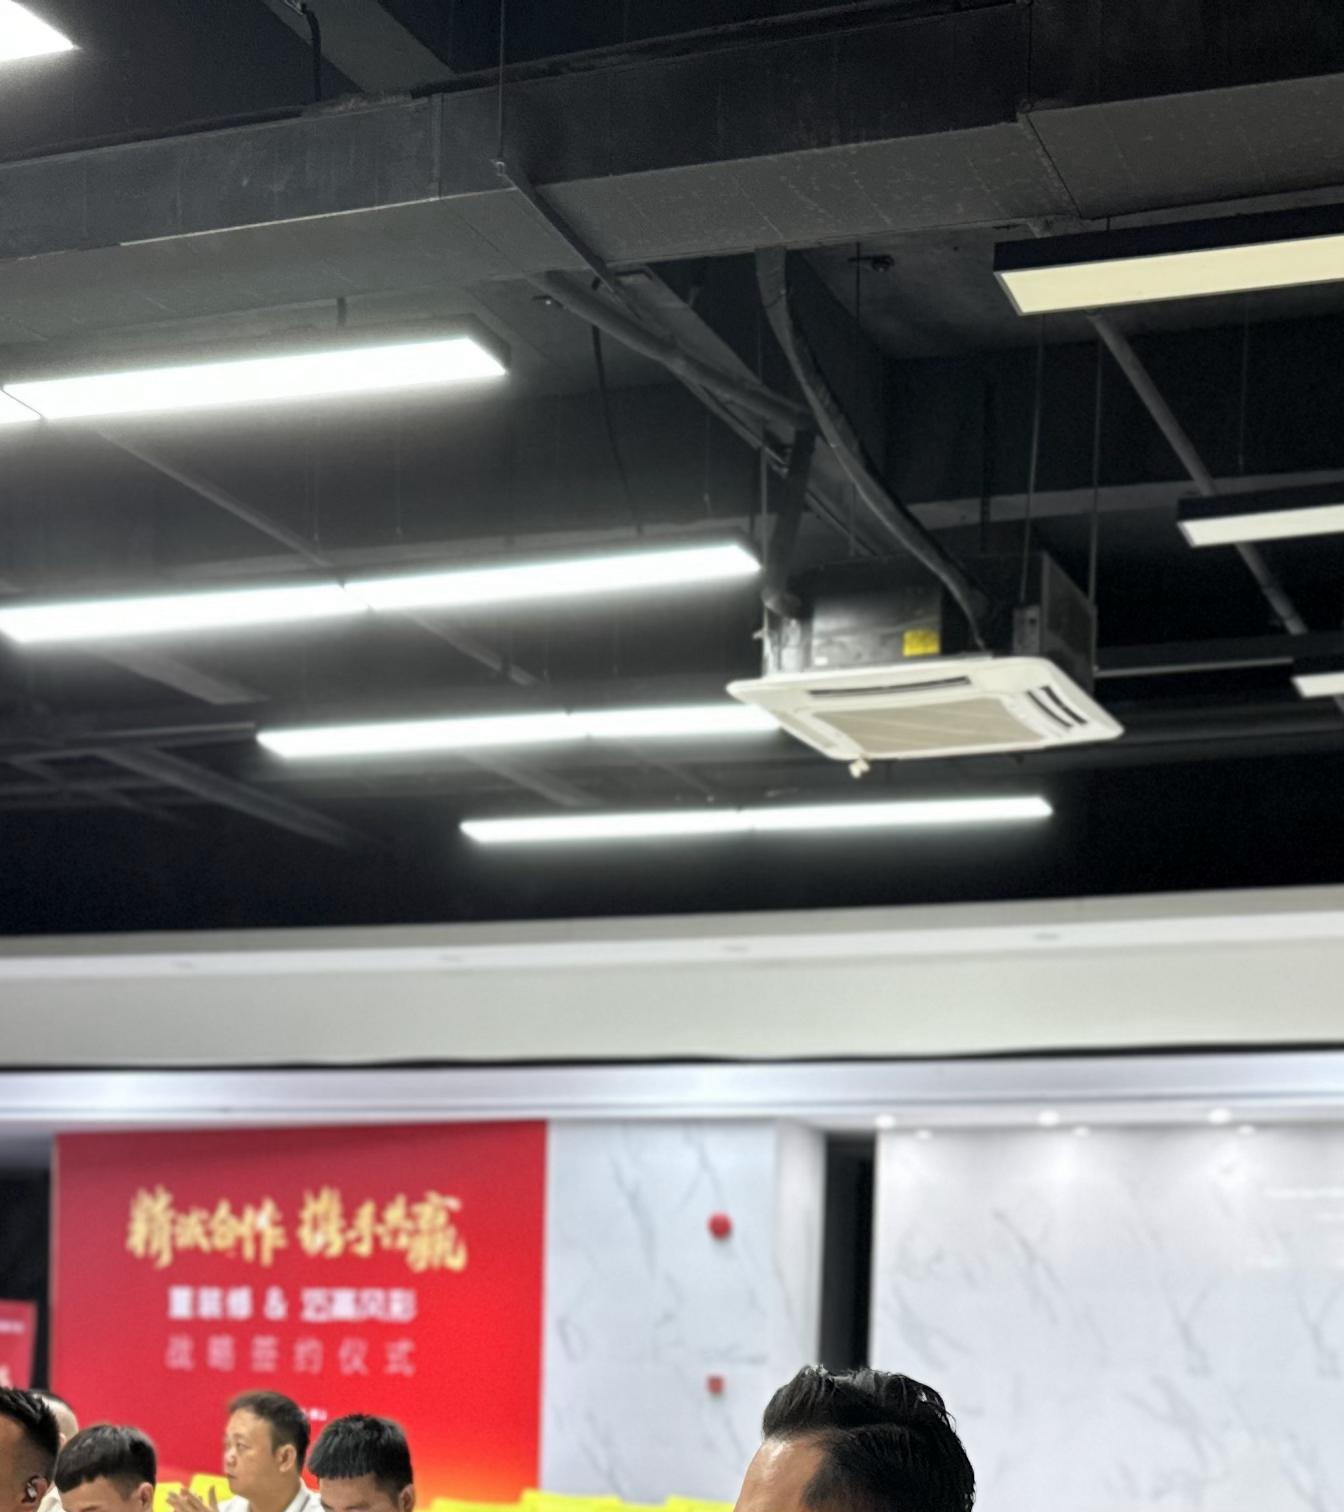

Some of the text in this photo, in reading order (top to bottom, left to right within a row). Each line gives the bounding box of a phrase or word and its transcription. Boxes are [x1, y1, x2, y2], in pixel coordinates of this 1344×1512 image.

[126, 1183, 467, 1272] 精诚合作 携手共赢
